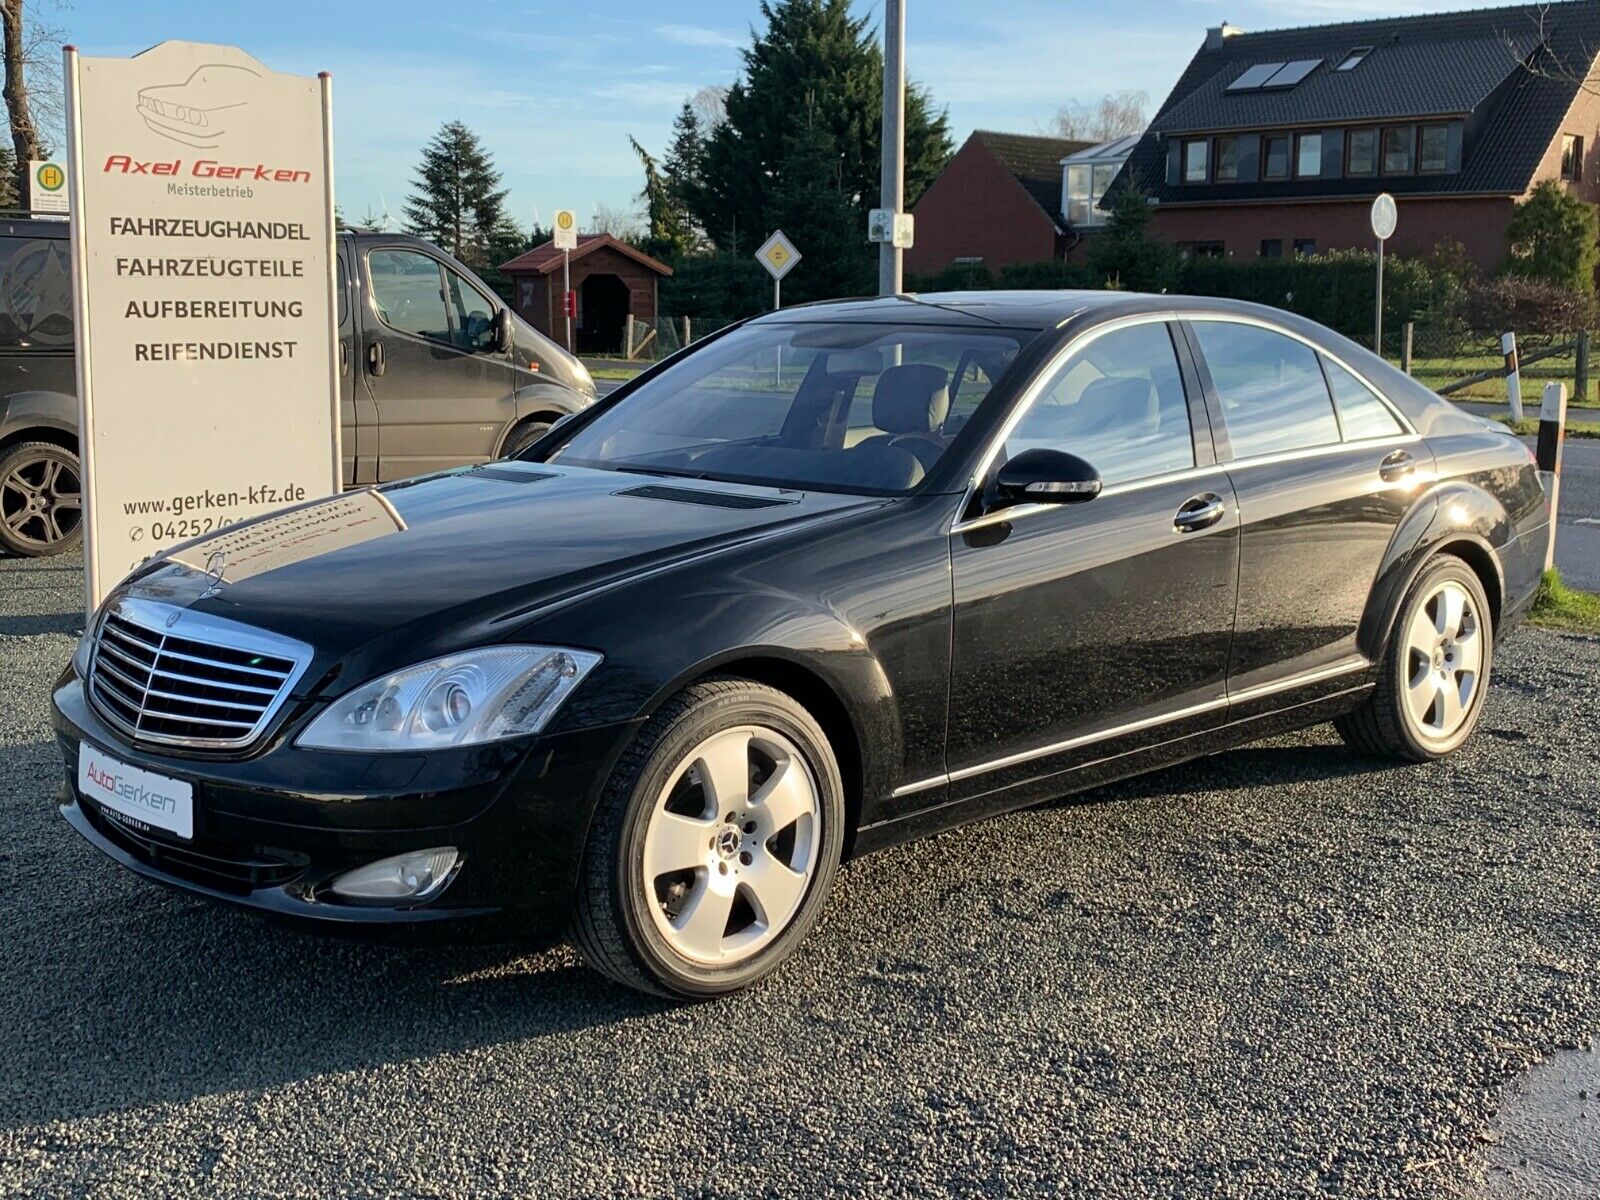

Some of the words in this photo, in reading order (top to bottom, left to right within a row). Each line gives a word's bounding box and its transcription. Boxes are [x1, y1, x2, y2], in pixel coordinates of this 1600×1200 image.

[45, 169, 57, 186] H
[103, 154, 182, 176] Axel
[191, 159, 312, 183] Gerken
[167, 182, 254, 199] Meisterbetrieb
[110, 216, 311, 241] FAHRZEUGHANDEL
[116, 257, 304, 278] FAHRZEUGTEILE
[124, 300, 303, 319] AUFBEREITUNG
[134, 341, 298, 362] REIFENDIENST
[122, 482, 306, 515] www.gerken-kfz.de
[87, 761, 176, 814] AutoGerken
